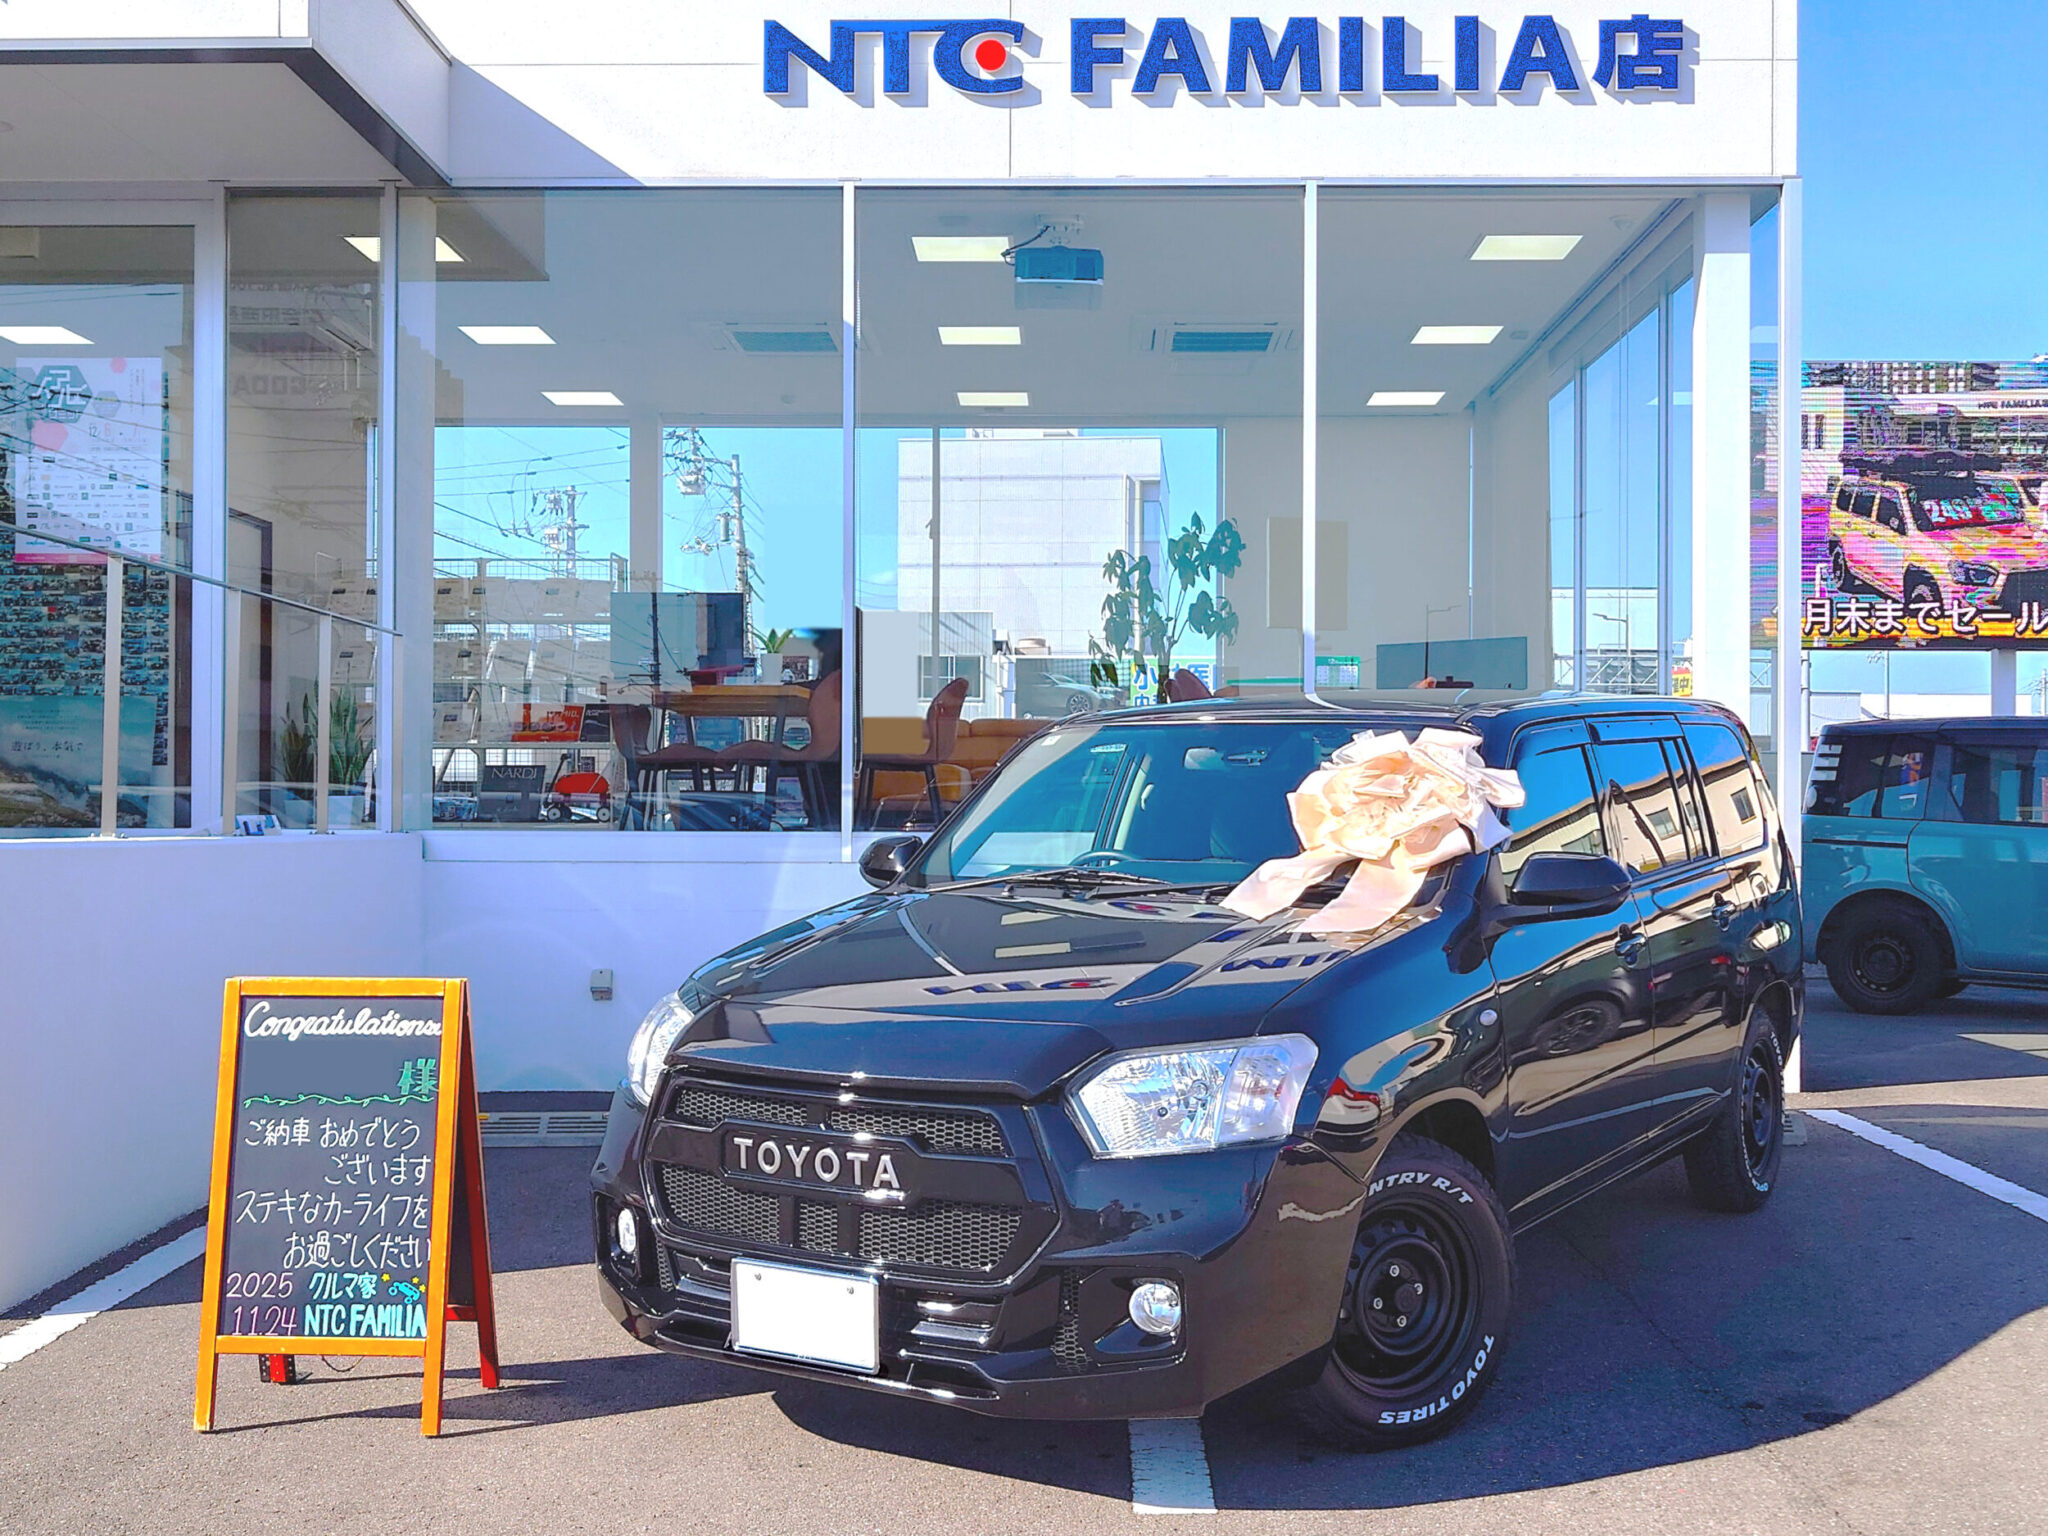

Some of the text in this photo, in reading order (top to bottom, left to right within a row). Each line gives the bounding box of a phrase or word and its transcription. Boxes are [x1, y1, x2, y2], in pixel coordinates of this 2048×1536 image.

[764, 14, 1683, 95] NTC FAMILIA店
[491, 767, 538, 780] NARDI
[396, 1058, 440, 1095] 様
[244, 1117, 421, 1150] ご納車 おめでとう
[324, 1152, 431, 1186] ございます
[732, 1137, 901, 1189] TOYOTA
[1432, 1176, 1474, 1205] R/T
[235, 1188, 429, 1229] ステキなカーライフを
[283, 1229, 431, 1270] お過ごしください
[226, 1272, 293, 1298] 2025
[308, 1272, 378, 1300] クルマ家
[304, 1303, 428, 1337] NTC FAMILIA
[1378, 1334, 1496, 1425] TOYO TIRES
